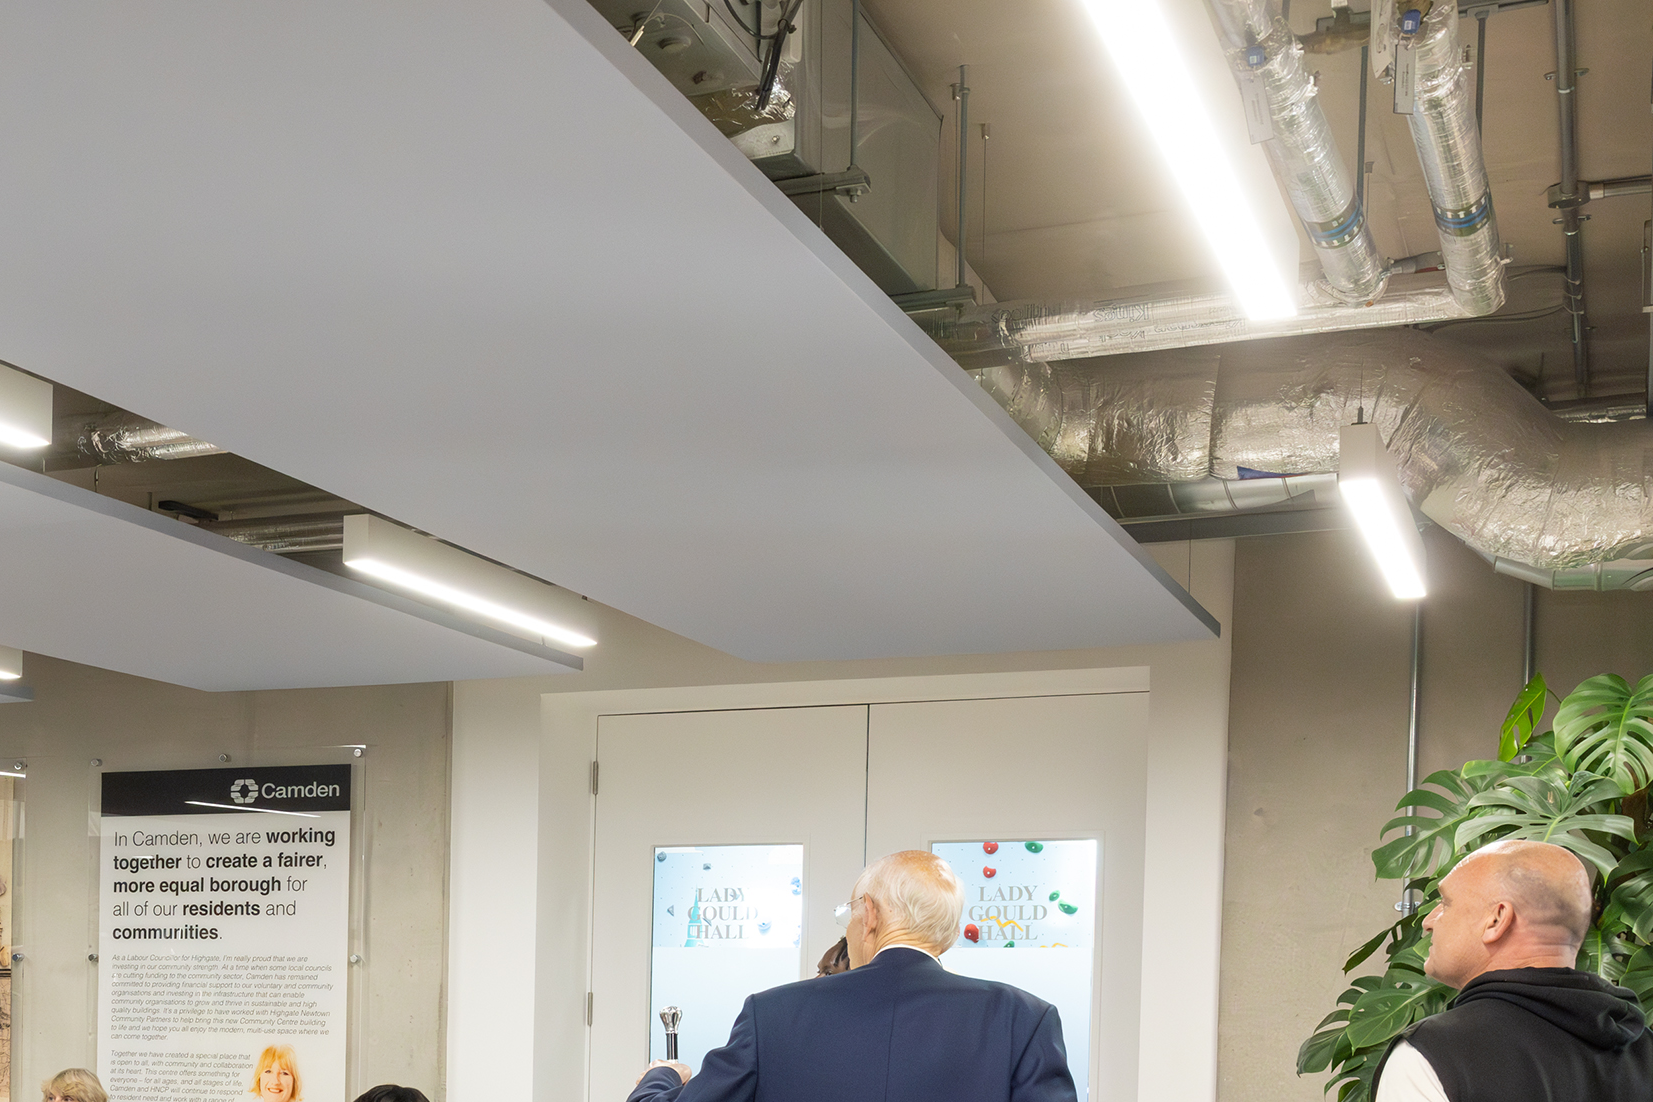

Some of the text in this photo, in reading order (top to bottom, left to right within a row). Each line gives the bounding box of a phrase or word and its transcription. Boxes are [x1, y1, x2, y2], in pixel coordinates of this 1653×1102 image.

[262, 782, 340, 799] Camden
[114, 828, 335, 847] In Camden, we are working
[114, 852, 327, 873] together to create a fairer,
[114, 876, 308, 896] more equal borough for
[978, 886, 1038, 901] LADY
[697, 888, 745, 902] LADY
[113, 900, 296, 916] all of our residents and
[688, 906, 758, 921] GOULD
[968, 905, 1047, 921] GOULD
[112, 925, 223, 940] communities.
[978, 925, 1038, 940] HALL
